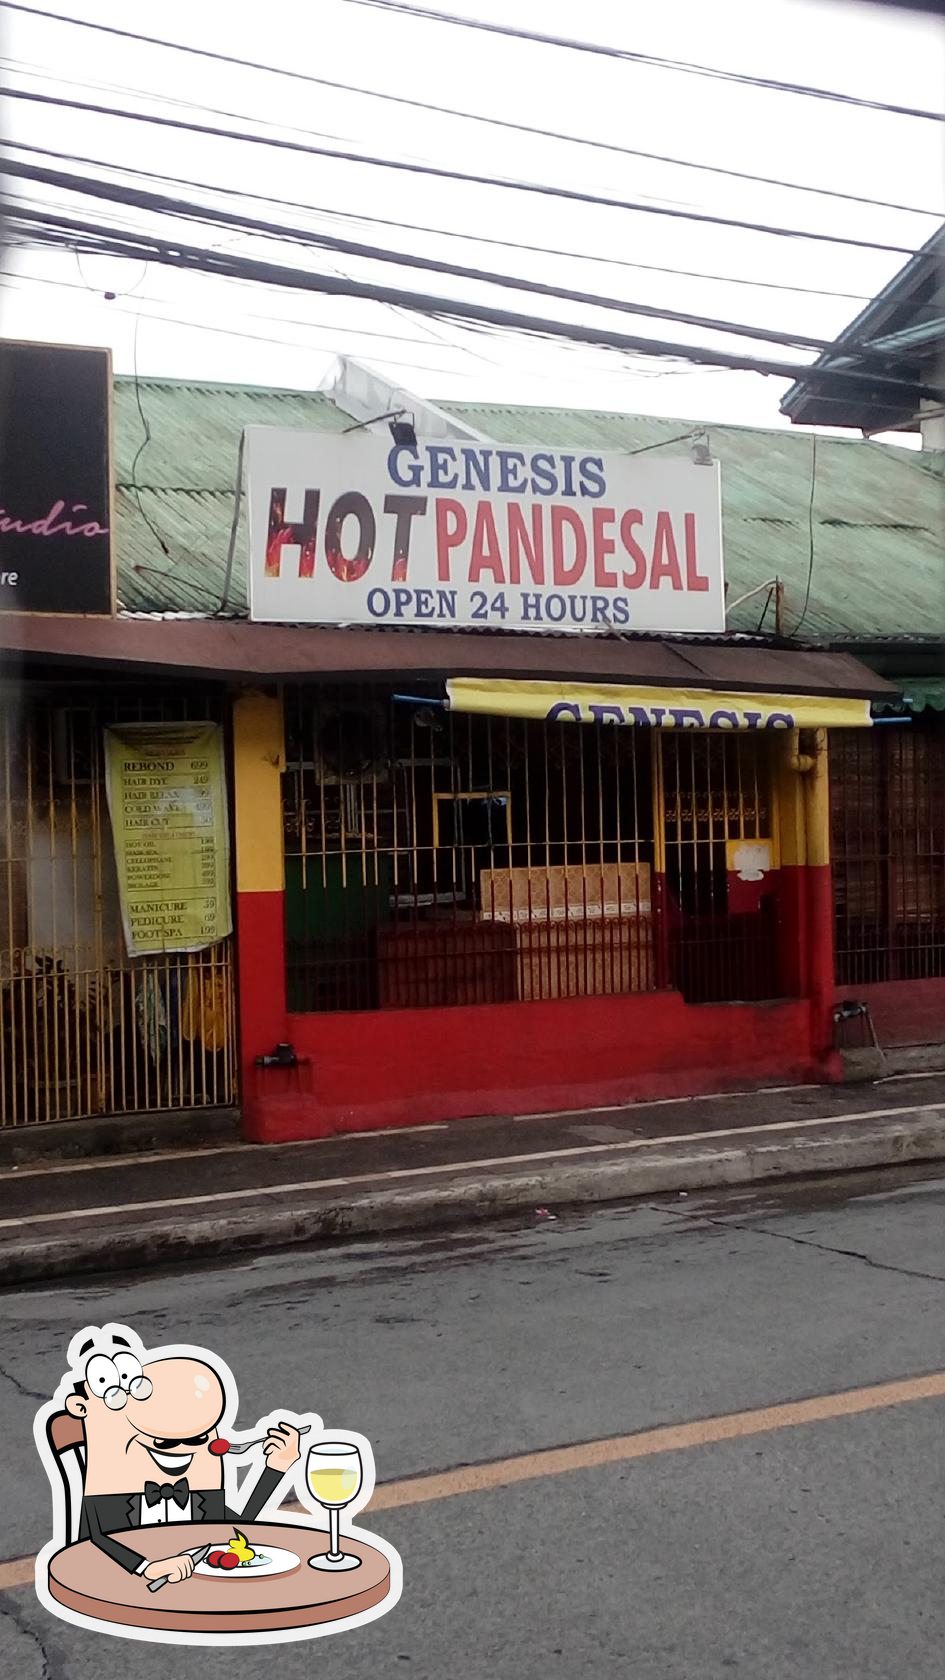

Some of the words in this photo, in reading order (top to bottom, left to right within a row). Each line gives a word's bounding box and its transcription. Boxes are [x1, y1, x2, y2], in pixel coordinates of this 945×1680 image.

[388, 444, 606, 499] GENESIS
[264, 487, 429, 582] HOT
[434, 497, 710, 592] PANDESAL
[367, 587, 458, 619] OPEN
[469, 592, 510, 620] 24
[520, 592, 631, 624] HOURS
[124, 761, 175, 772] REBOND
[190, 760, 209, 770] 699
[123, 777, 147, 785] HAIR
[124, 791, 147, 800] HAIR
[124, 804, 151, 813] COLD
[125, 818, 148, 827] HAIR
[150, 817, 169, 826] CUT
[130, 902, 188, 913] MANICURE
[130, 914, 185, 927] PEDICURE
[132, 929, 160, 940] FOOT
[163, 928, 183, 938] SPA
